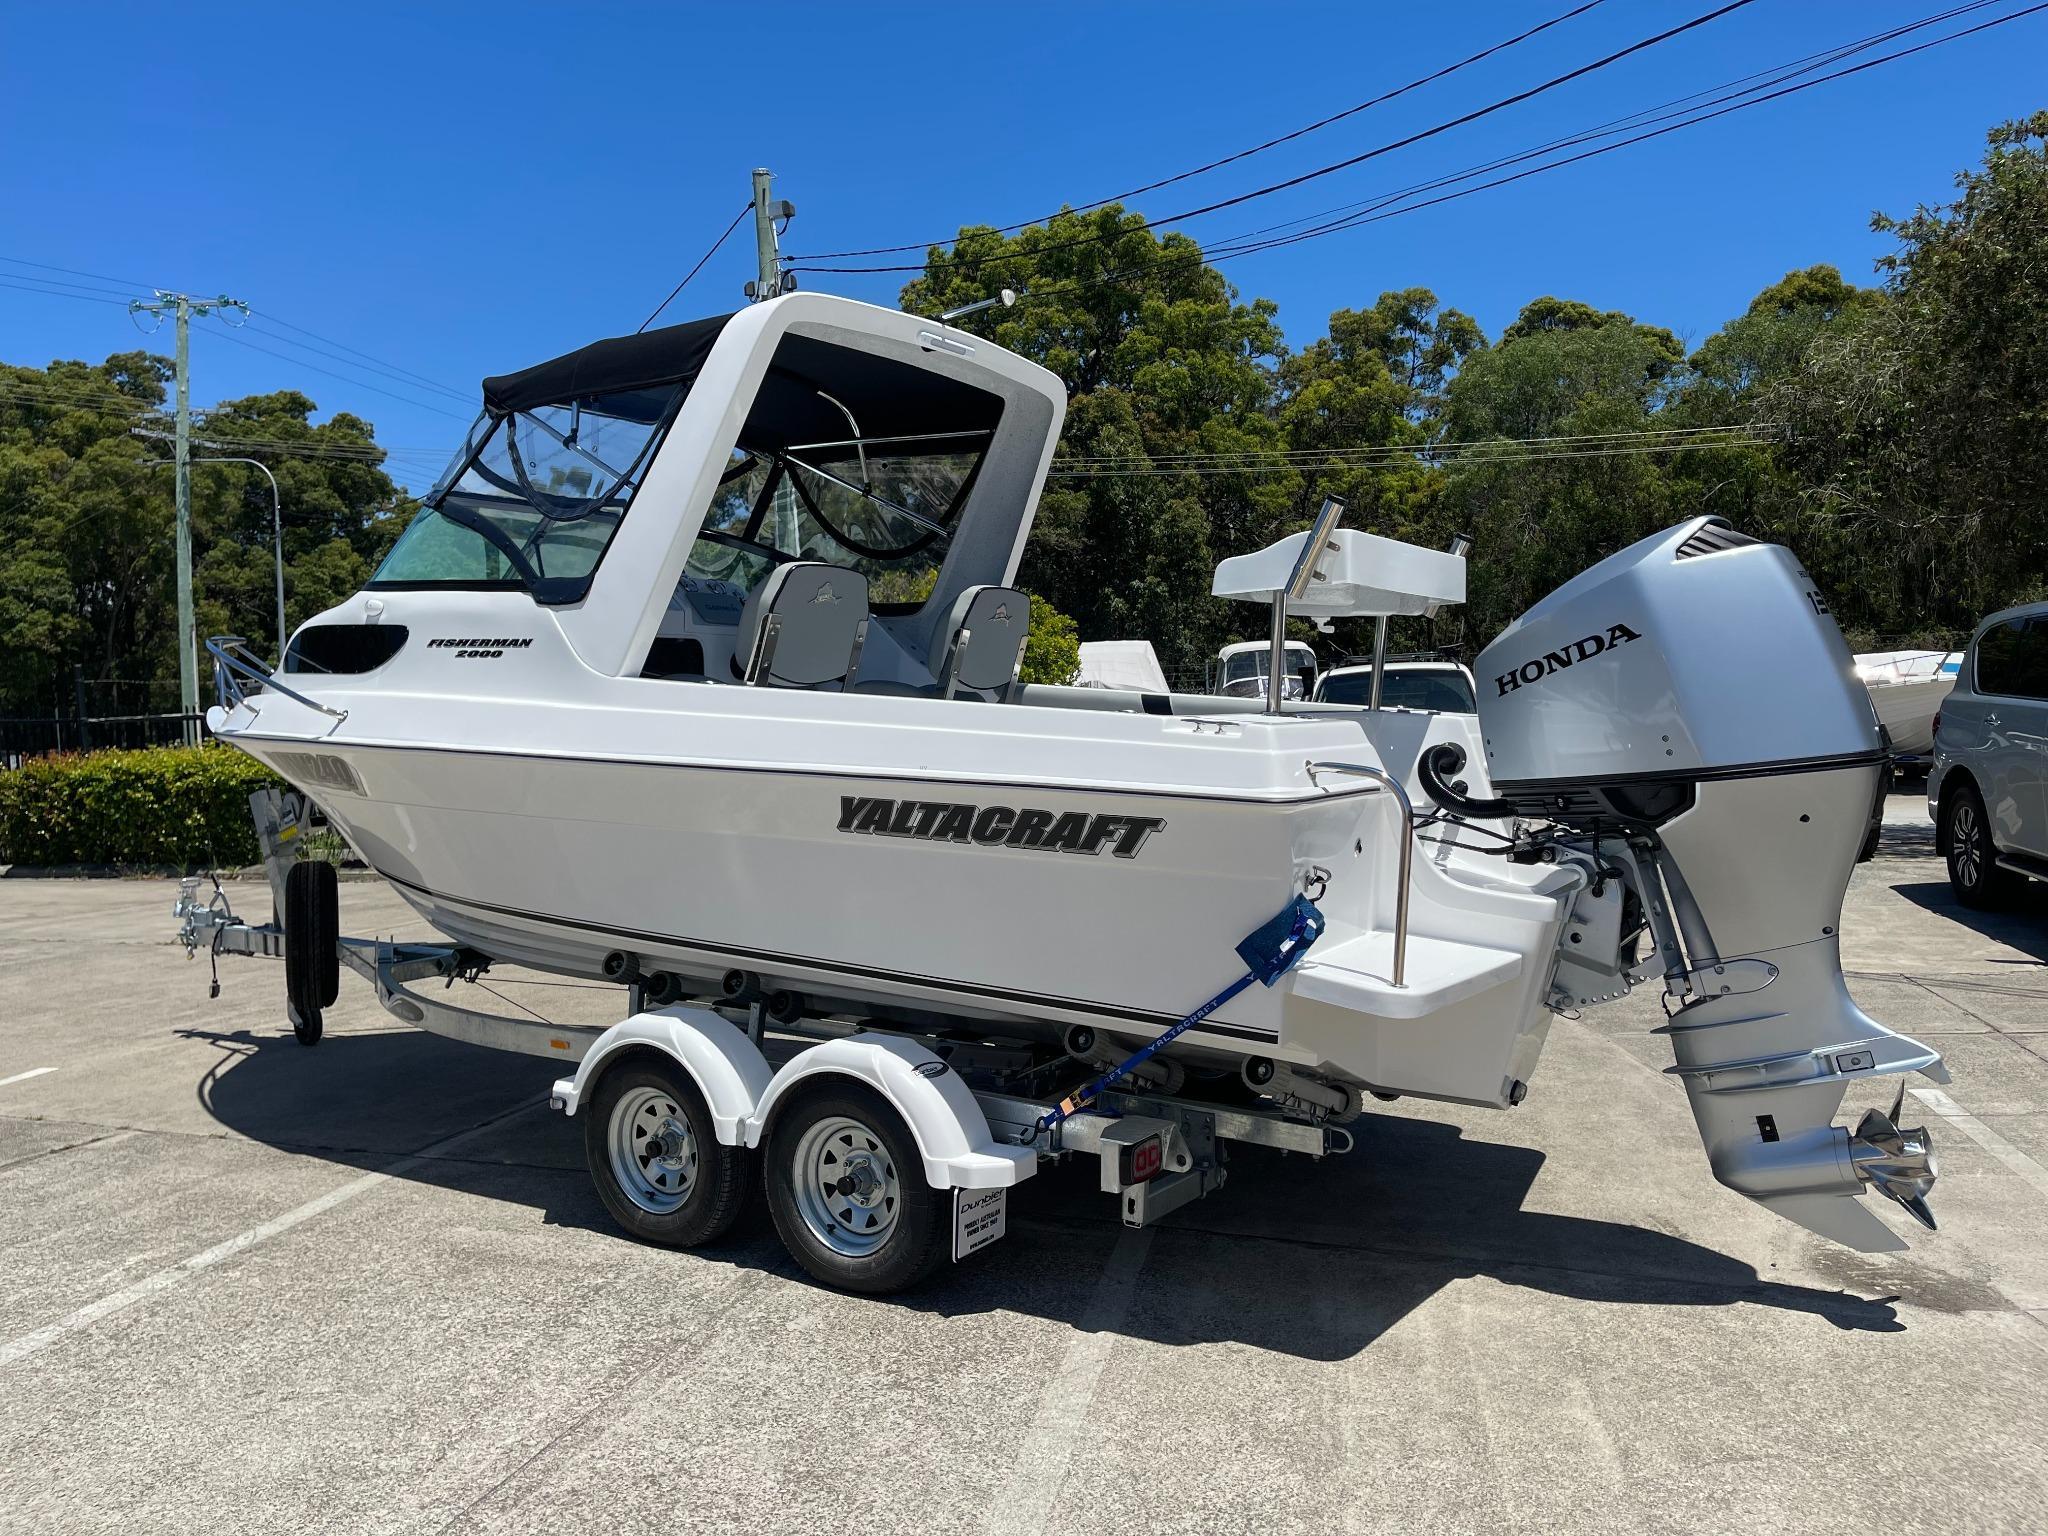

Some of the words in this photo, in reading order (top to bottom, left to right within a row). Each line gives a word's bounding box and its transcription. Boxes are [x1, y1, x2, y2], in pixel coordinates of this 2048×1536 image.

[426, 638, 534, 649] FISHERMAN
[454, 650, 504, 659] 2000
[1495, 623, 1642, 697] HONDA
[836, 795, 1168, 859] YALTACRAFT
